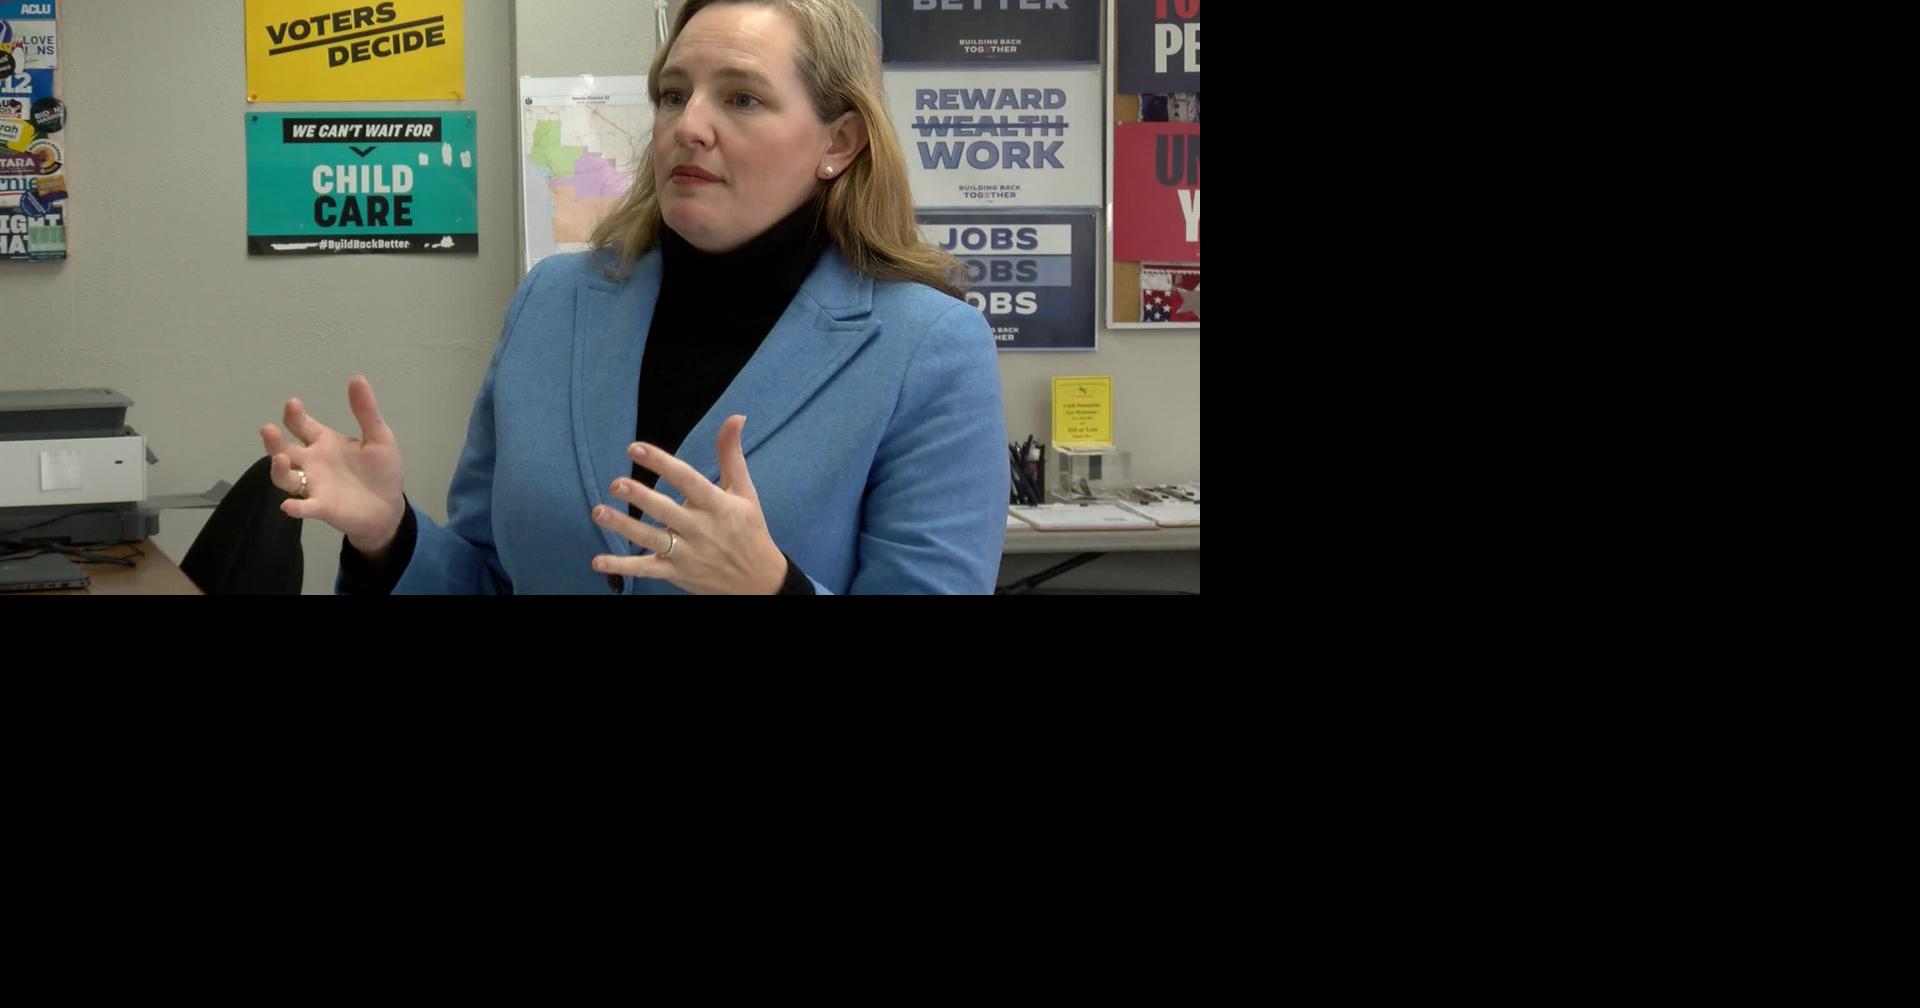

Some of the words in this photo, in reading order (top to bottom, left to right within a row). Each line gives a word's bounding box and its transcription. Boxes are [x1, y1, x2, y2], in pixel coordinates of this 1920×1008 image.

[21, 4, 51, 14] ACLU
[266, 2, 397, 45] VOTERS
[328, 25, 446, 68] DECIDE
[915, 88, 1067, 110] REWARD
[293, 124, 317, 138] WE
[319, 123, 363, 138] CAN'T
[365, 123, 403, 138] WAIT
[405, 122, 434, 138] FOR
[915, 115, 1065, 137] WEALTH
[916, 141, 1065, 170] WORK
[312, 164, 413, 194] CHILD
[314, 195, 413, 228] CARE
[939, 227, 1039, 251] JOBS
[961, 260, 1039, 283] OBS
[965, 291, 1038, 315] OBS
